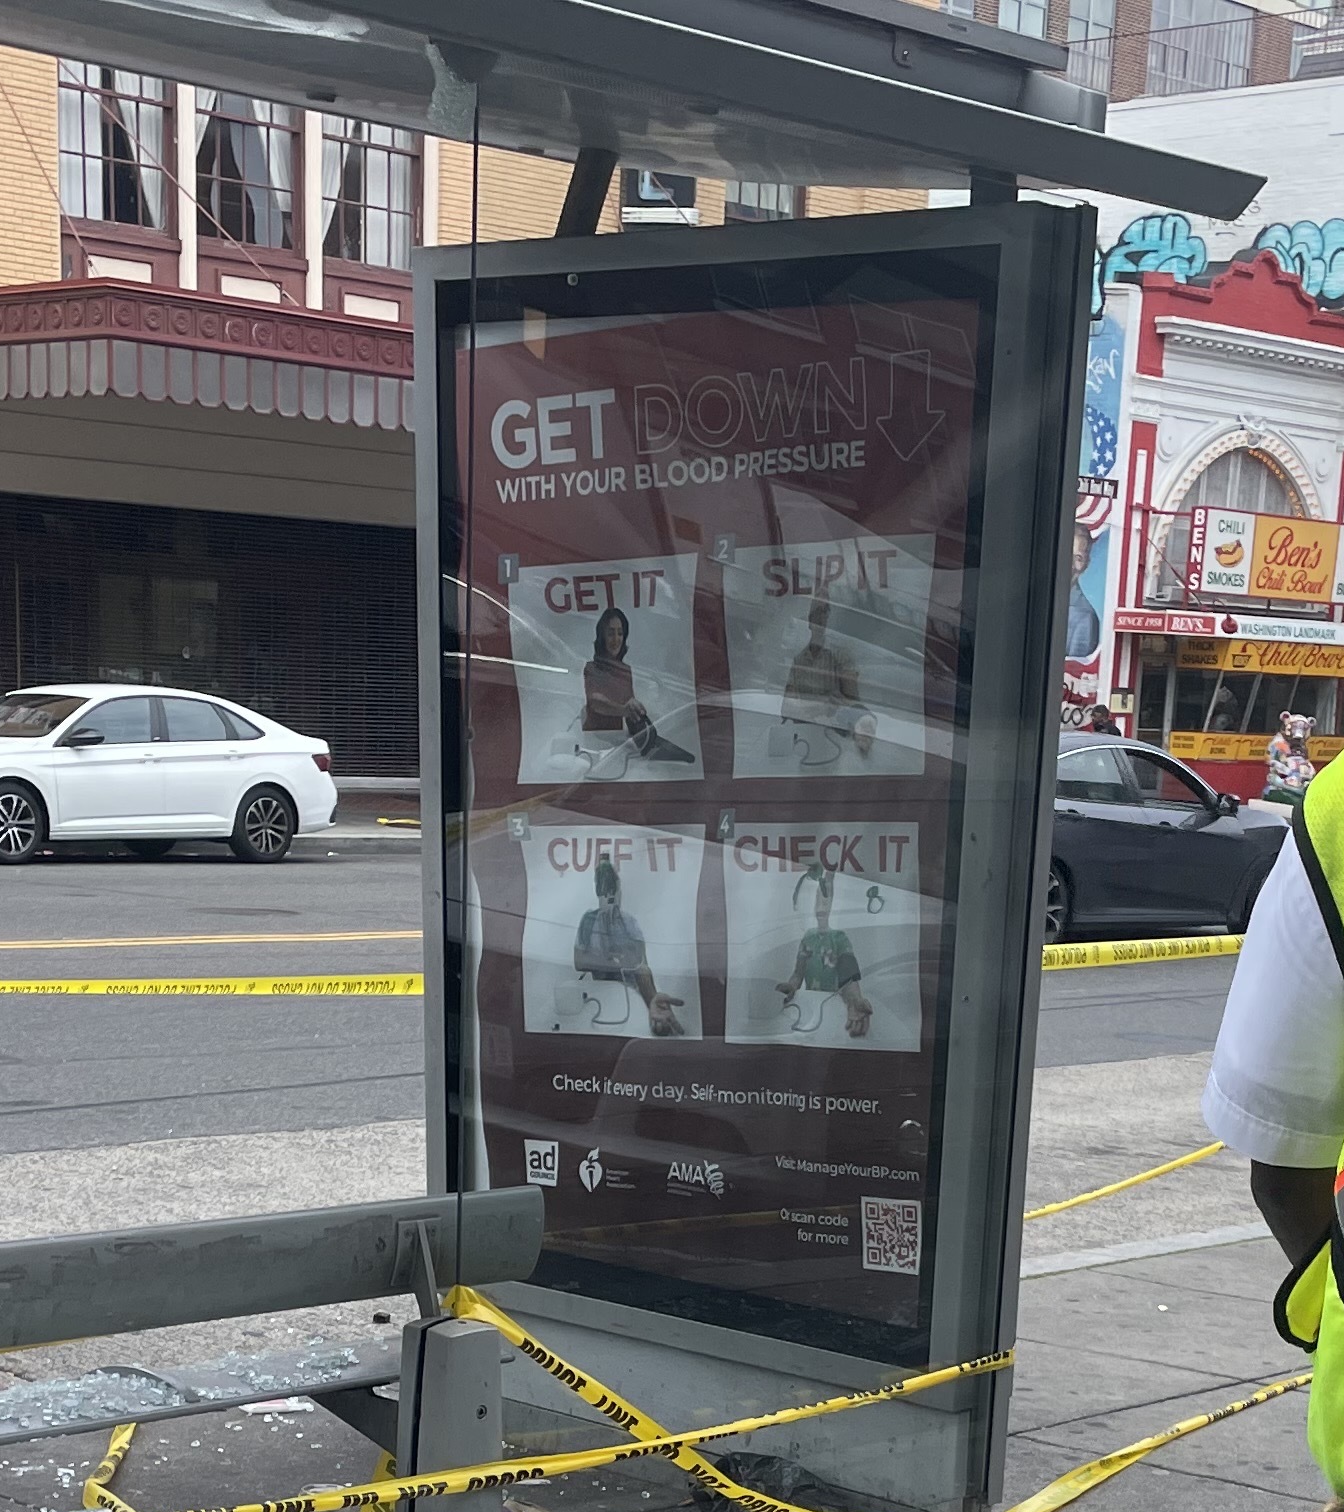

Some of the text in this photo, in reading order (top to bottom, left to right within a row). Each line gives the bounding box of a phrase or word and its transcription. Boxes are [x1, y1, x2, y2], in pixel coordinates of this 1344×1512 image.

[490, 357, 868, 470] GET DOWN
[495, 440, 867, 504] WITH YOUR BLOOD PRESSURE
[1217, 519, 1246, 536] CHILI
[718, 539, 730, 560] 2
[1188, 508, 1206, 591] BEN'S
[1264, 526, 1323, 570] Ben's
[503, 557, 513, 579] 1
[764, 549, 897, 598] SLIP IT
[1206, 571, 1246, 588] SMOKES
[543, 569, 665, 615] GET IT
[1256, 566, 1329, 595] Chili Bowl
[1116, 616, 1144, 627] SINCE
[1240, 623, 1337, 641] WASHINGTON LANDMARK
[1182, 653, 1219, 666] SHAKES
[511, 818, 526, 836] 3
[719, 814, 731, 834] 4
[547, 836, 683, 874] CUFF IT
[733, 834, 911, 873] CHECK IT
[552, 1074, 883, 1115] Check it every day. Self-monitoring is power.
[529, 1145, 556, 1172] ad
[667, 1161, 706, 1185] AMA
[796, 1159, 920, 1182] ManageYourBP.com
[780, 1207, 849, 1227] Or scan code
[797, 1228, 849, 1246] for more
